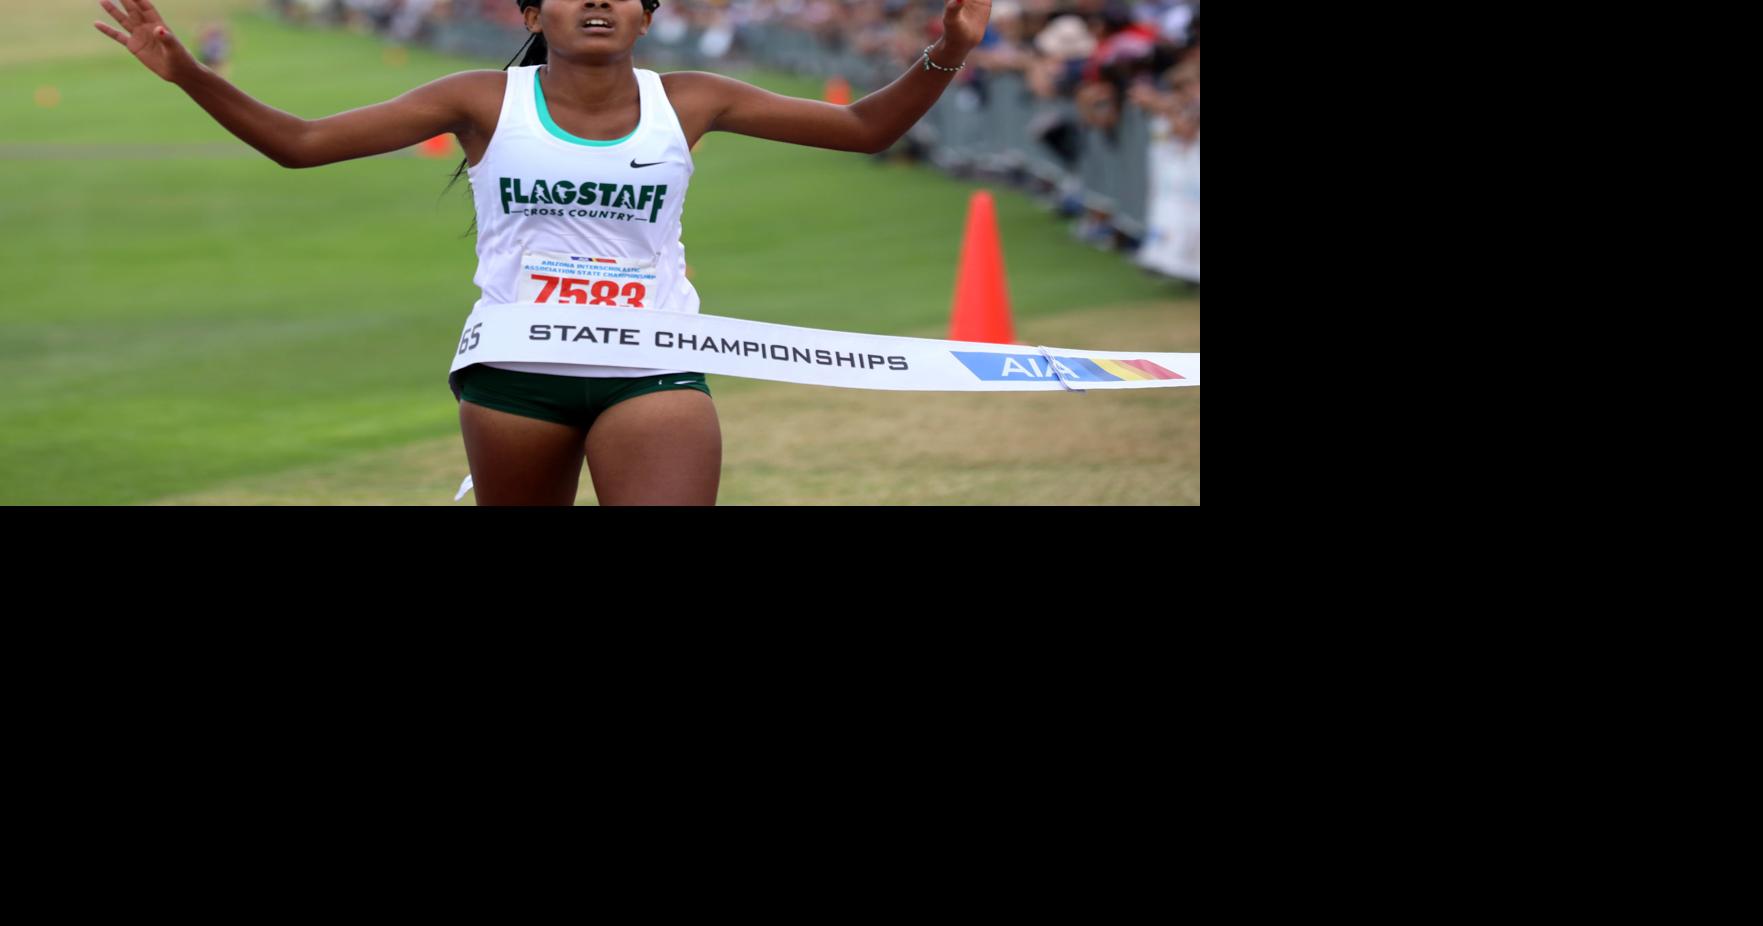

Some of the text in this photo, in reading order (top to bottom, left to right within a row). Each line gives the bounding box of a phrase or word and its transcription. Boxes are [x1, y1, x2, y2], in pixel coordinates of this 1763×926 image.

[499, 177, 668, 223] FLAGSTAFF
[524, 208, 635, 221] CROSS COUNTRY
[524, 265, 576, 275] ASSOCIATION
[542, 260, 641, 273] ARIZONA INTERSCHOLASTIC
[530, 273, 646, 308] 7583
[529, 324, 641, 346] STATE
[654, 331, 909, 371] CHAMPIONSHIPS
[1001, 357, 1080, 379] AIA
